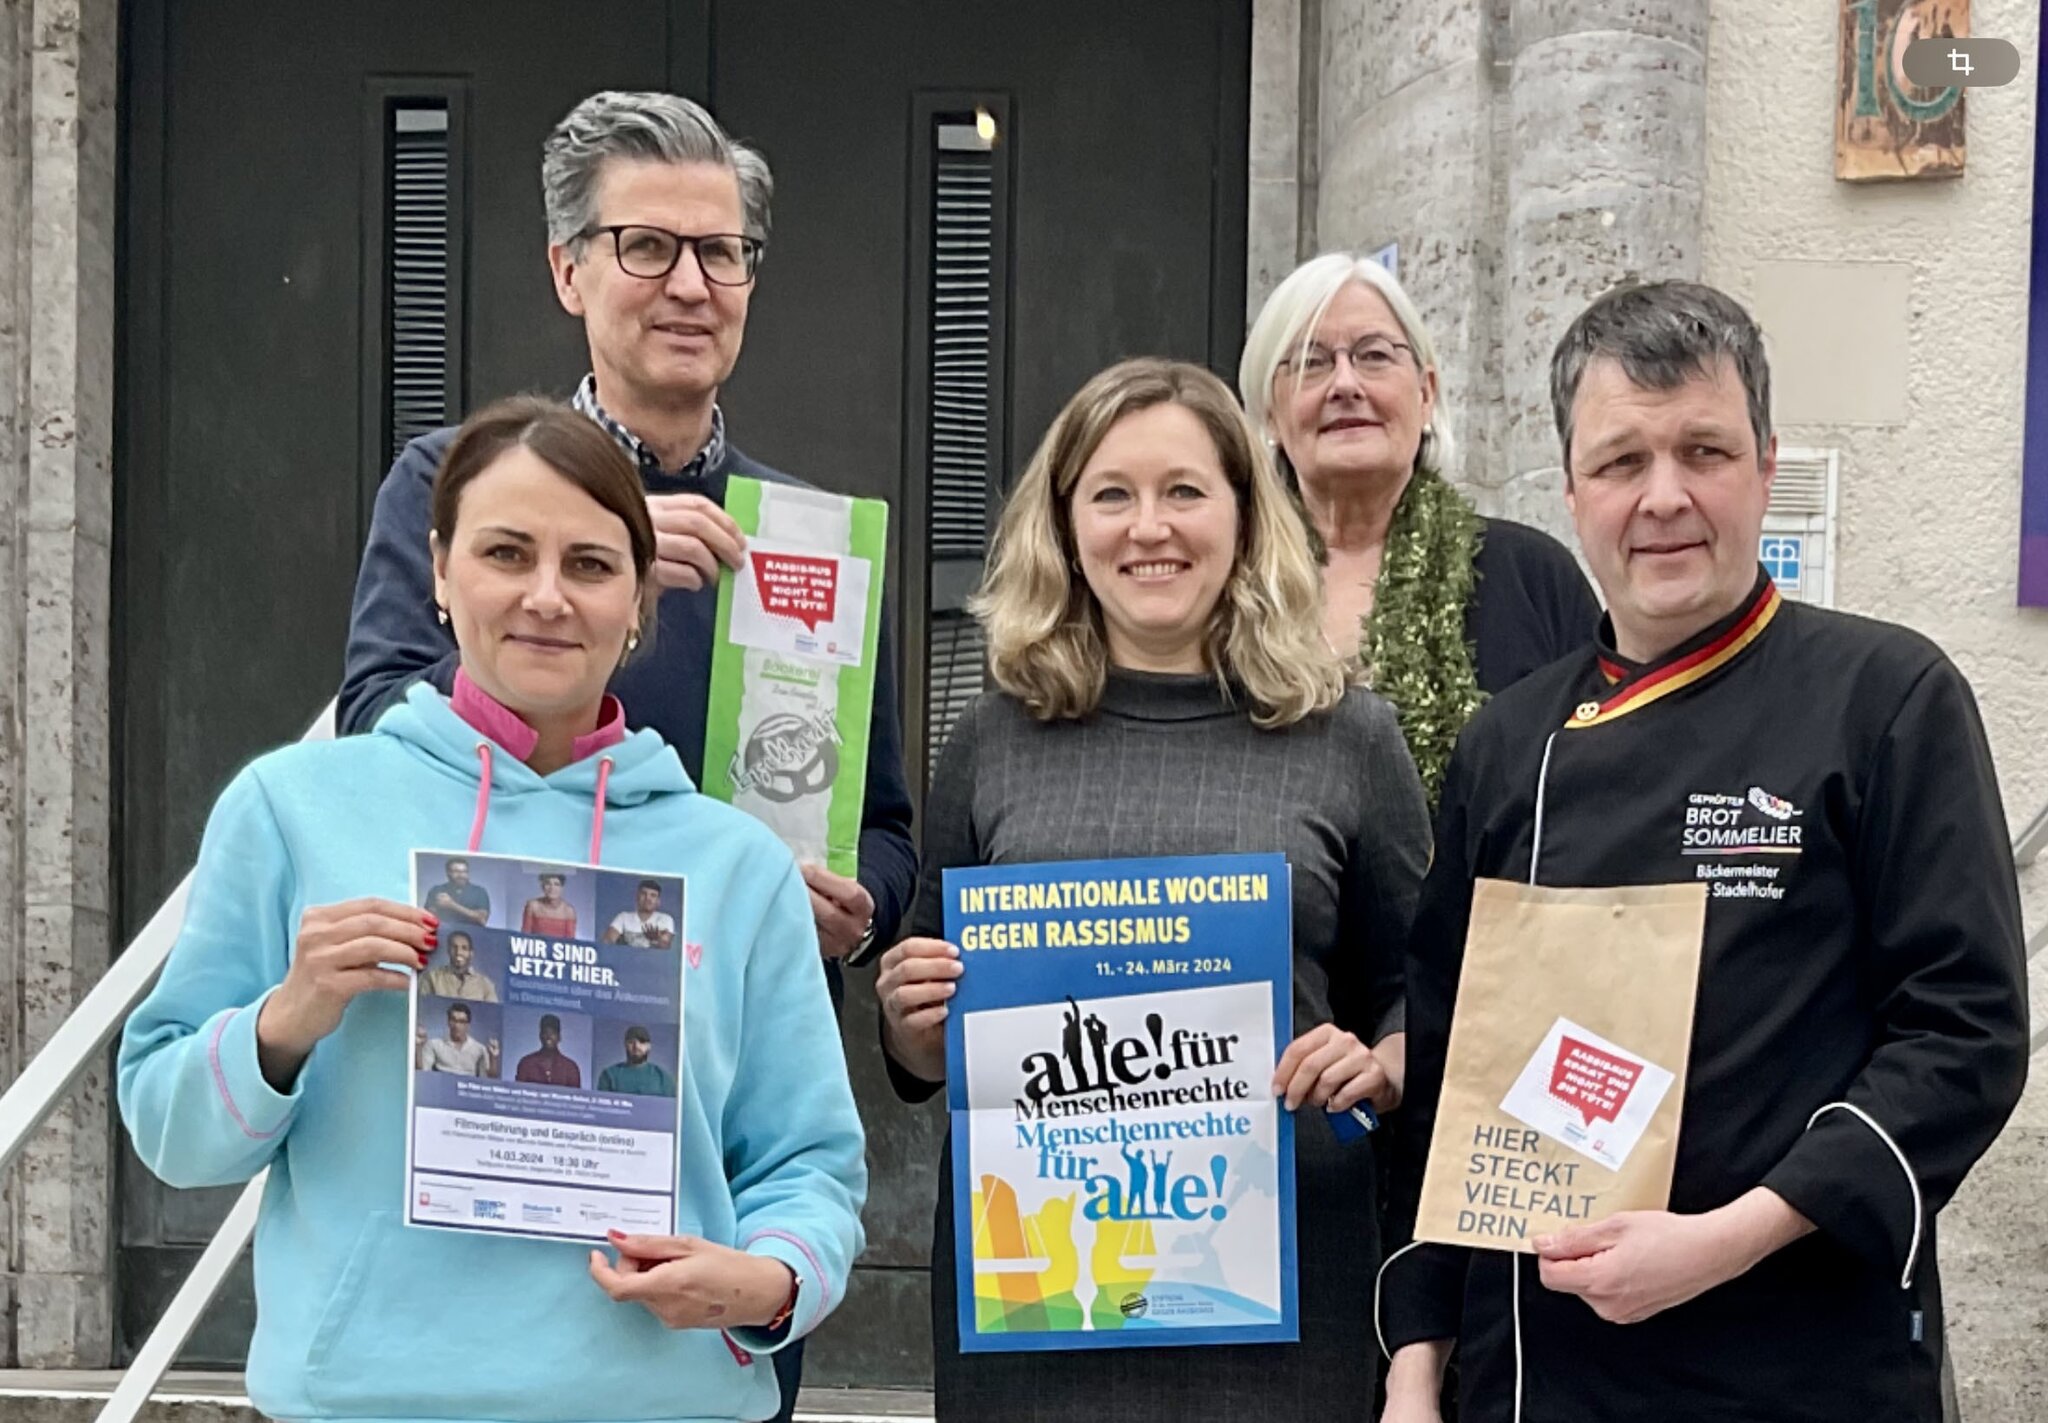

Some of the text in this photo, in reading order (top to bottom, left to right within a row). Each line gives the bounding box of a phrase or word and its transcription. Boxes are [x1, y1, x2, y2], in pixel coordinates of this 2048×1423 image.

[1686, 807, 1742, 825] BROT
[1682, 825, 1802, 846] SOMMELIER
[1696, 863, 1780, 879] Bäckermeister
[960, 874, 1269, 914] INTERNATIONALE WOCHEN
[1712, 880, 1786, 900] Stadelhofer
[961, 917, 1191, 951] GEGEN RASSISMUS
[510, 935, 597, 965] WIR SIND
[1152, 958, 1189, 974] März
[1193, 957, 1232, 973] 2024
[509, 956, 620, 987] JETZT HIER.
[1170, 1029, 1240, 1070] für
[1013, 1077, 1249, 1122] Menschenrechte
[455, 1117, 529, 1138] Filmvorführung
[531, 1127, 549, 1138] und
[551, 1128, 597, 1143] Gespräch
[599, 1134, 635, 1148] (online)
[1016, 1112, 1251, 1148] Menschenrechte
[1473, 1124, 1540, 1154] HIER
[489, 1149, 543, 1164] 14.03.2024
[582, 1158, 600, 1170] Uhr
[1037, 1145, 1098, 1180] für
[1468, 1153, 1579, 1186] STECKT
[1083, 1143, 1228, 1222] alle!
[1465, 1181, 1596, 1219] VIELFALT
[1457, 1210, 1527, 1239] DRIN
